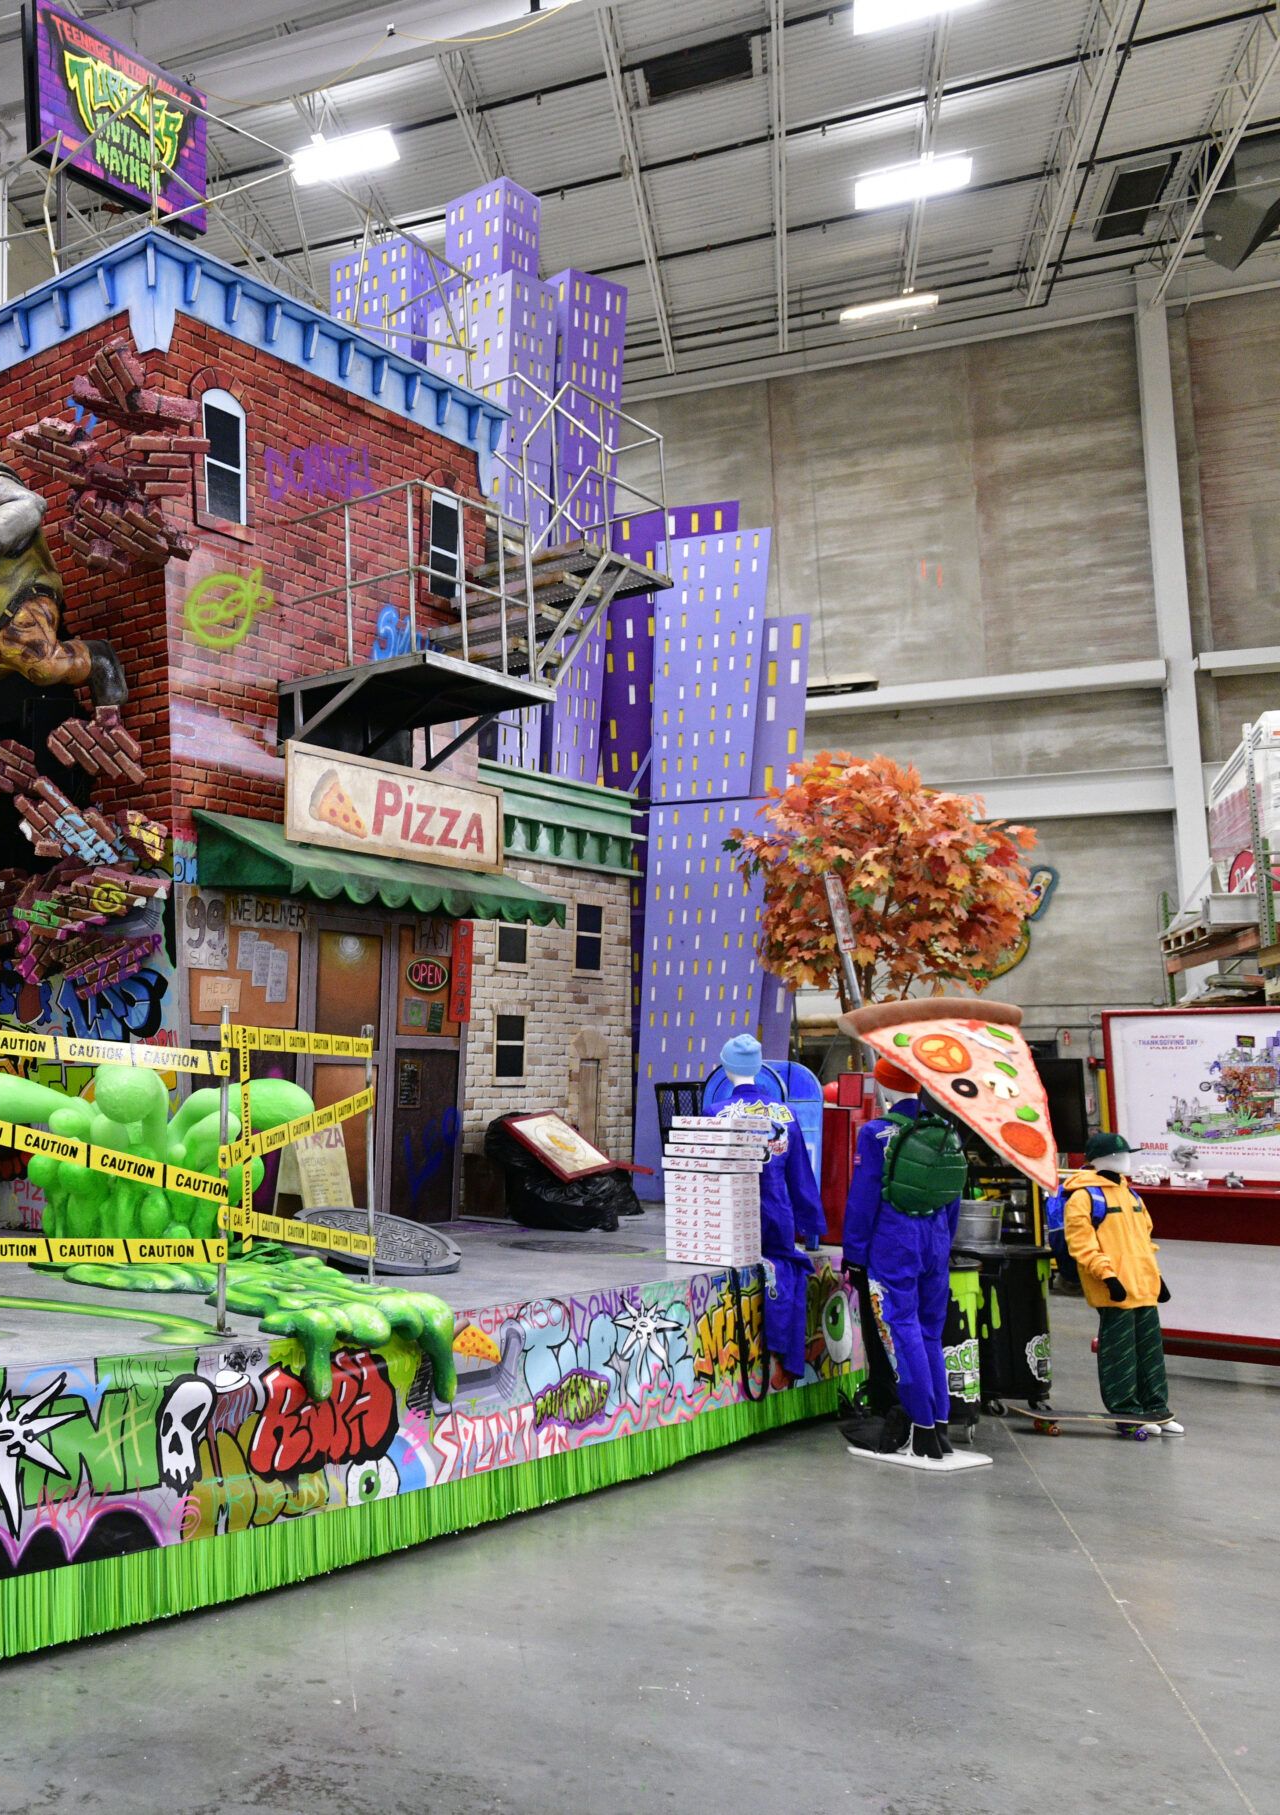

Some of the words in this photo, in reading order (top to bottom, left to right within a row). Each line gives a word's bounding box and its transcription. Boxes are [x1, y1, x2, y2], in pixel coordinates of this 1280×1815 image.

[50, 14, 112, 67] TEENAGE
[63, 50, 184, 173] TURTLES
[419, 919, 452, 952] FAST
[412, 963, 443, 986] OPEN
[457, 924, 470, 1016] PIZZA
[70, 1044, 124, 1059] CAUTION
[236, 1030, 255, 1044] CION
[263, 1034, 281, 1046] CAUTION
[289, 1037, 306, 1048] CAUTION
[313, 1039, 328, 1049] CAUTION
[335, 1040, 349, 1051] CAUTION
[355, 1041, 369, 1052] CAUTION
[266, 1131, 285, 1147] CAUTION
[293, 1121, 310, 1135] CAUTION
[317, 1111, 332, 1125] CAUTION
[338, 1103, 352, 1117] CAUTION
[355, 1094, 368, 1109] CAUTION
[1140, 1142, 1169, 1150] PARADE
[25, 1134, 78, 1158] CAUTION
[101, 1155, 155, 1179] CAUTION
[176, 1174, 228, 1198] CAUTION
[14, 1179, 48, 1202] PIZ
[60, 1244, 114, 1257] CAUTION
[139, 1245, 194, 1257] CAUTION
[262, 1220, 280, 1234] CAUTION
[287, 1225, 304, 1239] CAUTION
[312, 1230, 326, 1242] CAUTION
[333, 1233, 348, 1246] CAUTION
[354, 1237, 367, 1250] CAUTION
[534, 1371, 610, 1429] MUTANTS
